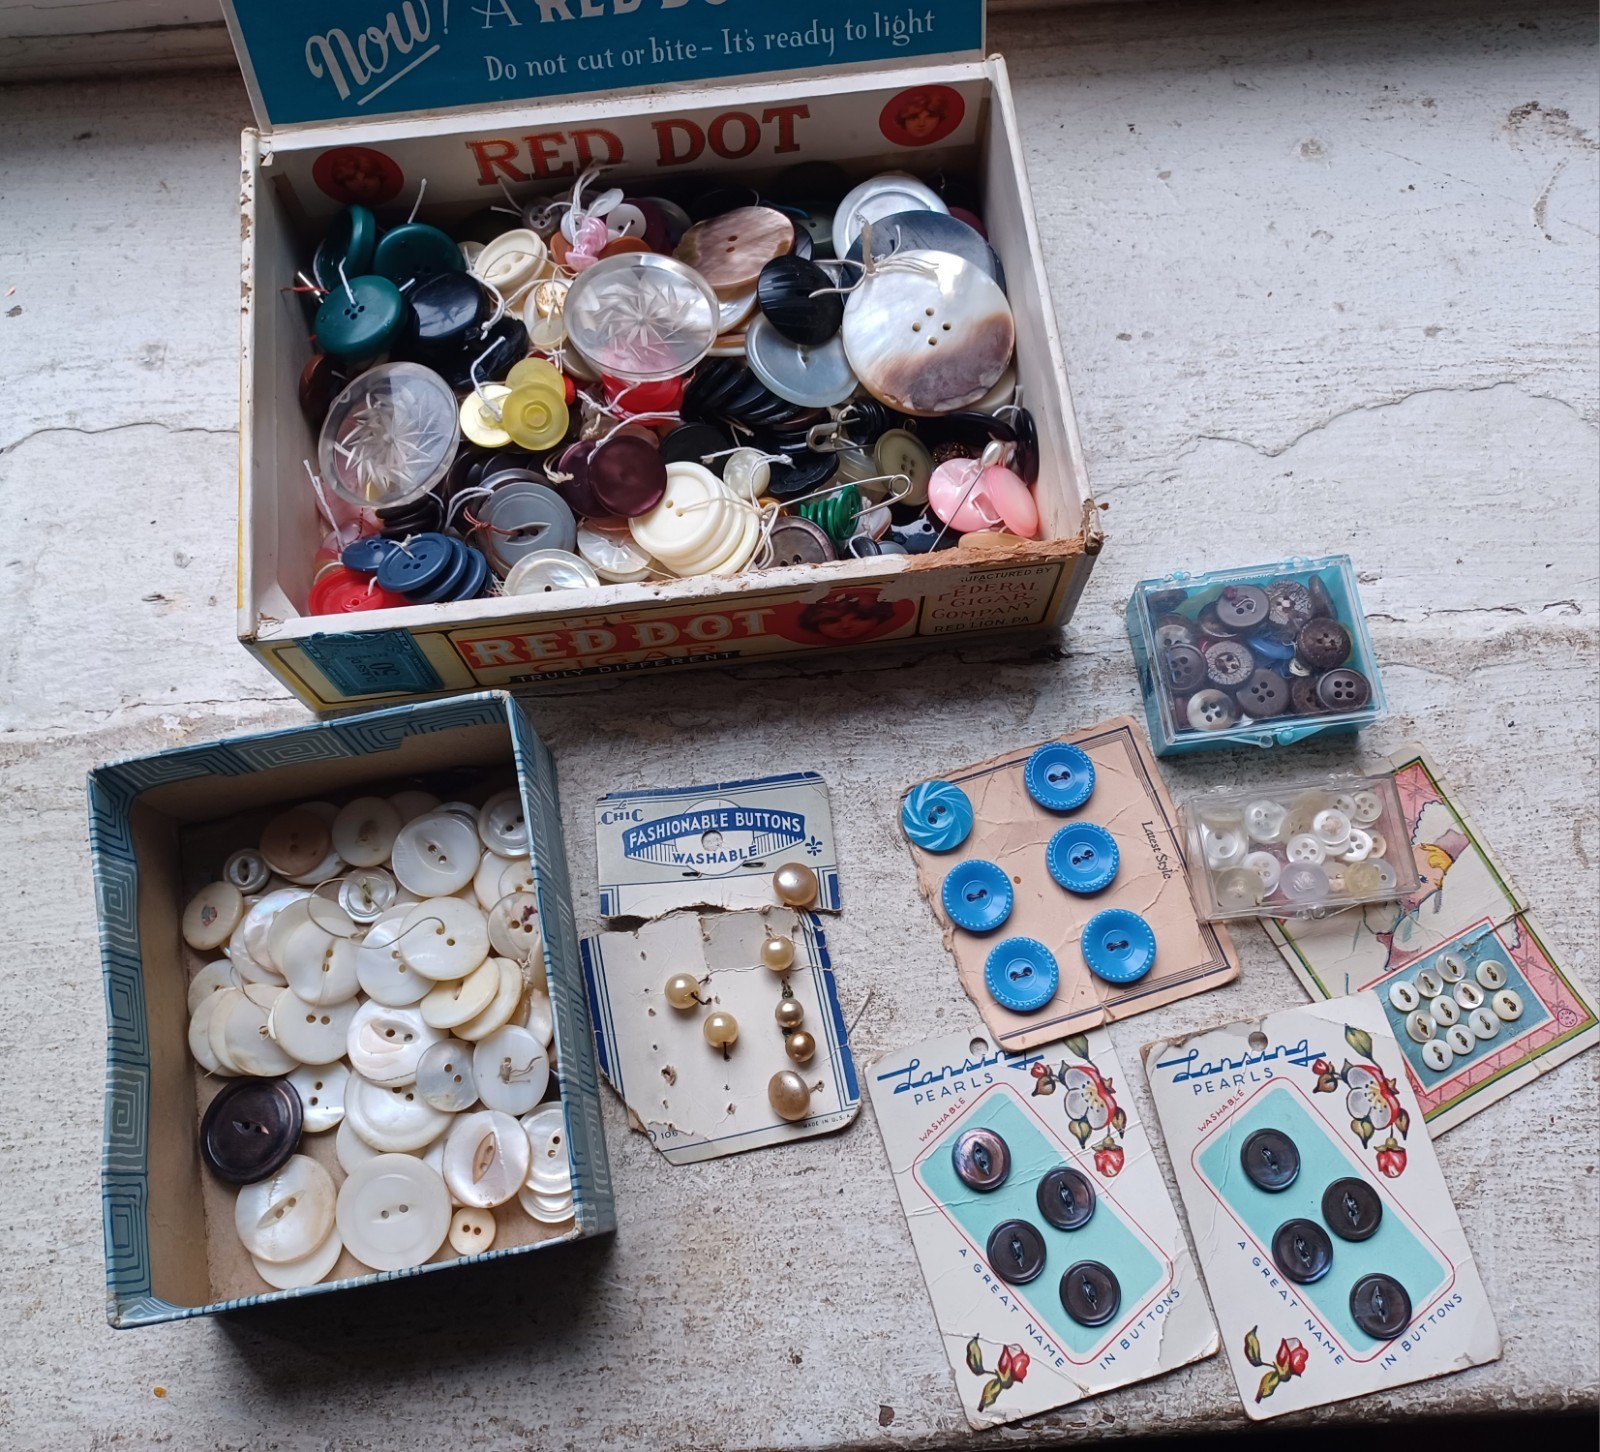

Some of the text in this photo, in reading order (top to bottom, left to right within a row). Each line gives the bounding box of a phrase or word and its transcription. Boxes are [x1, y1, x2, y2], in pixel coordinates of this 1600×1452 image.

[305, 0, 449, 101] Now!
[484, 55, 517, 81] Do
[525, 53, 567, 77] not
[577, 48, 615, 71] cut
[621, 49, 645, 67] or
[721, 28, 755, 55] It's
[764, 19, 835, 57] ready
[844, 18, 867, 40] to
[873, 8, 936, 46] light
[465, 104, 811, 186] RED DOT
[960, 566, 1054, 583] UFACTURED BY
[932, 598, 1038, 620] COMPANY
[934, 622, 965, 633] RED
[464, 608, 777, 667] RED DOT
[532, 645, 721, 672] CIGAR
[517, 652, 733, 684] TRULY DIFFERENT
[600, 808, 644, 825] CHIC
[629, 813, 801, 848] FASHIONABLE BUTTONS
[673, 845, 757, 865] WASHABLE
[1141, 820, 1172, 880] Latest Style
[1156, 1039, 1326, 1083] Lansing
[1194, 1067, 1274, 1096] PEARLS
[913, 1072, 994, 1105] PEARLS
[919, 1097, 966, 1142] WASHABLE
[1197, 1089, 1245, 1133] WASHABLE
[958, 1248, 1064, 1368] A GREAT NAME
[1237, 1241, 1344, 1365] A GREAT NAME
[1099, 1288, 1180, 1370] IN BUTTONS
[1380, 1293, 1463, 1371] IN BUTTONS
